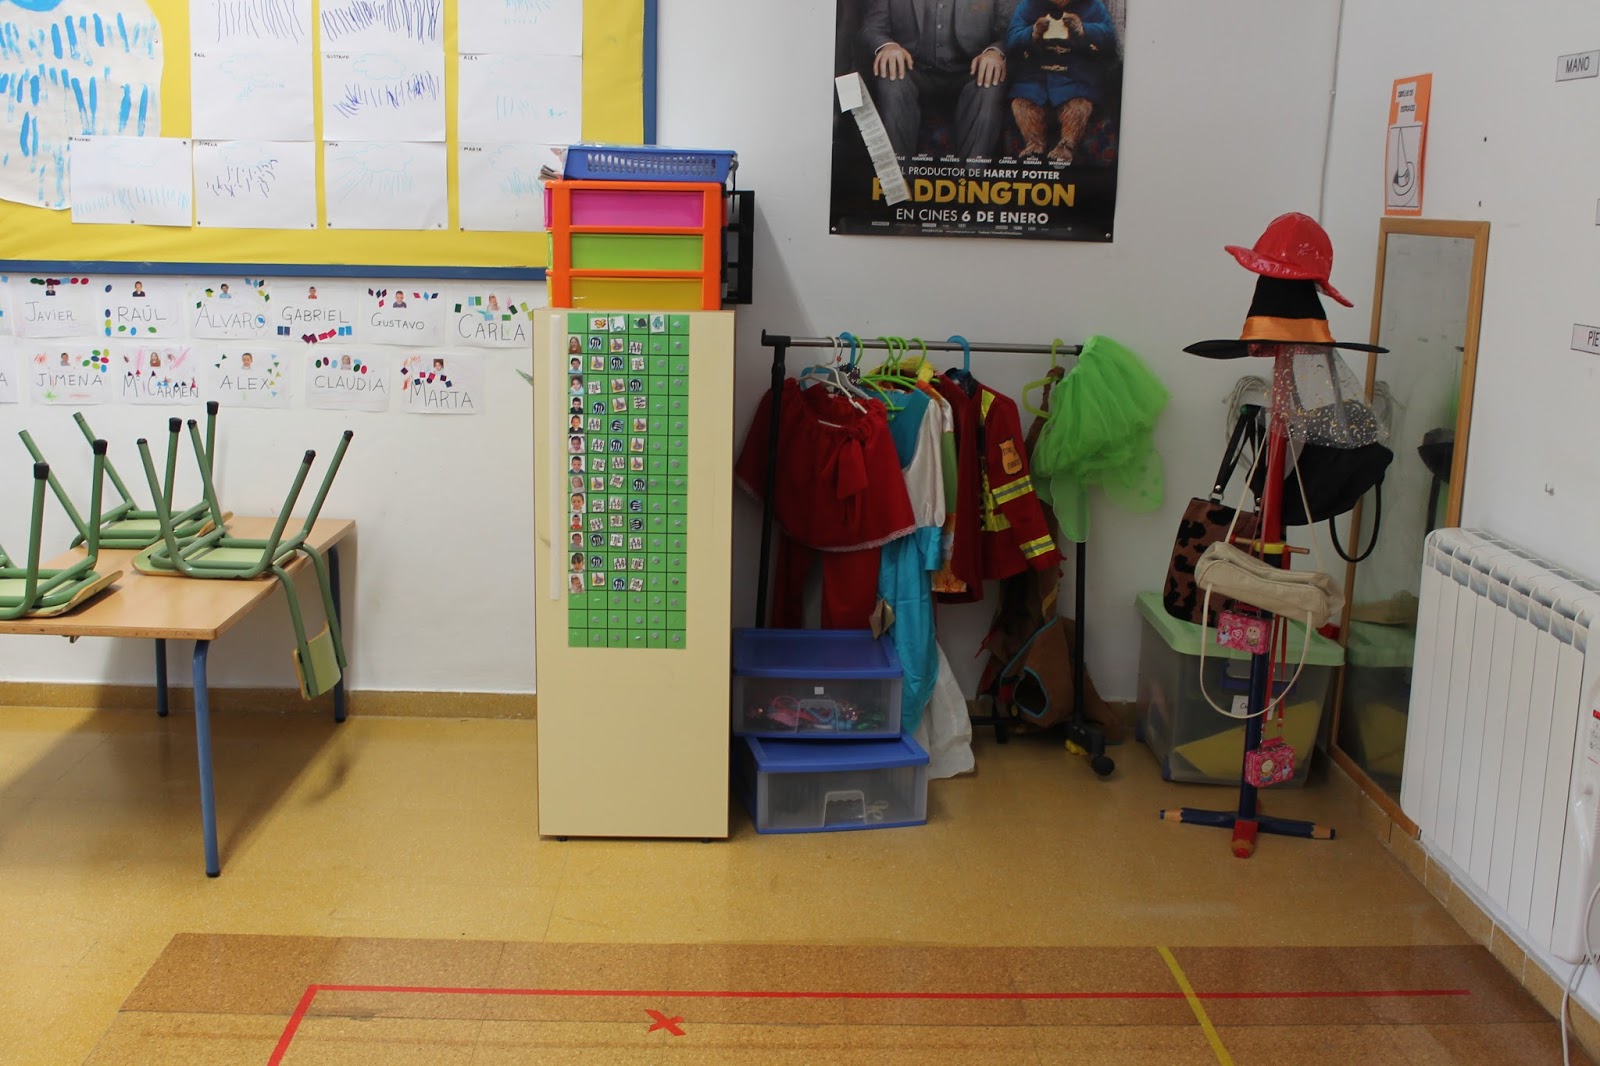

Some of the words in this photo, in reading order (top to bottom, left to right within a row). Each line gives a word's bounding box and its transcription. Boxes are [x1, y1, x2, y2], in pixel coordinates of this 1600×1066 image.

[1565, 56, 1590, 73] MANO
[908, 166, 966, 177] PRODUCTOR
[968, 168, 980, 178] DE
[983, 169, 1019, 179] HARRY
[1022, 170, 1060, 180] POTTER
[872, 176, 1075, 207] PDDINGTON
[896, 208, 914, 220] EN
[919, 209, 958, 221] CINES
[961, 210, 971, 222] 6
[976, 211, 994, 222] DE
[1000, 211, 1049, 224] ENERO
[117, 304, 167, 322] RAÚL
[370, 311, 425, 330] GUSTAVO
[458, 313, 526, 341] CARLA
[36, 373, 103, 387] JIMENA
[220, 375, 270, 390] ALEX
[314, 375, 386, 394] CLAUDIA
[410, 379, 474, 409] MARTA
